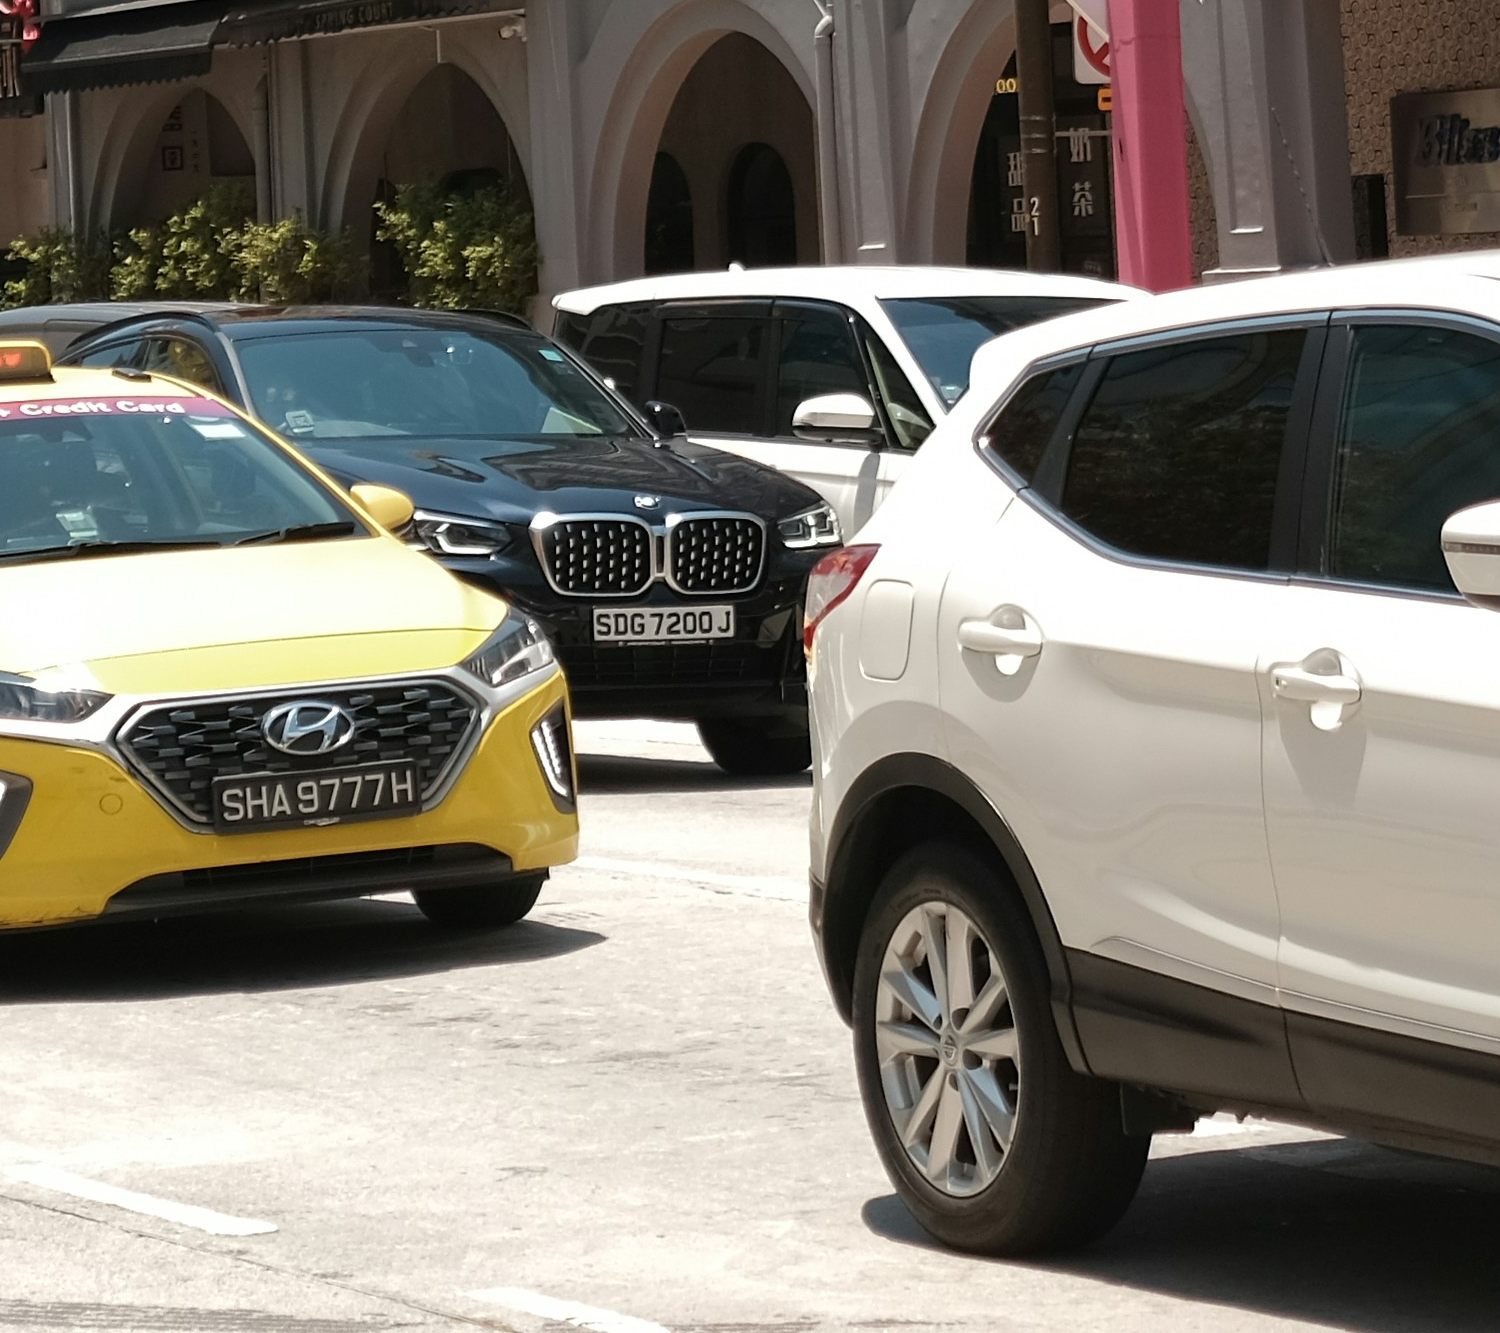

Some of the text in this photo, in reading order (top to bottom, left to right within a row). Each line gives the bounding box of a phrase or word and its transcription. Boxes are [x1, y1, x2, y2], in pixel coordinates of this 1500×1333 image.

[315, 1, 394, 30] SPRING COURT
[18, 400, 112, 417] Credit
[115, 398, 187, 415] Card
